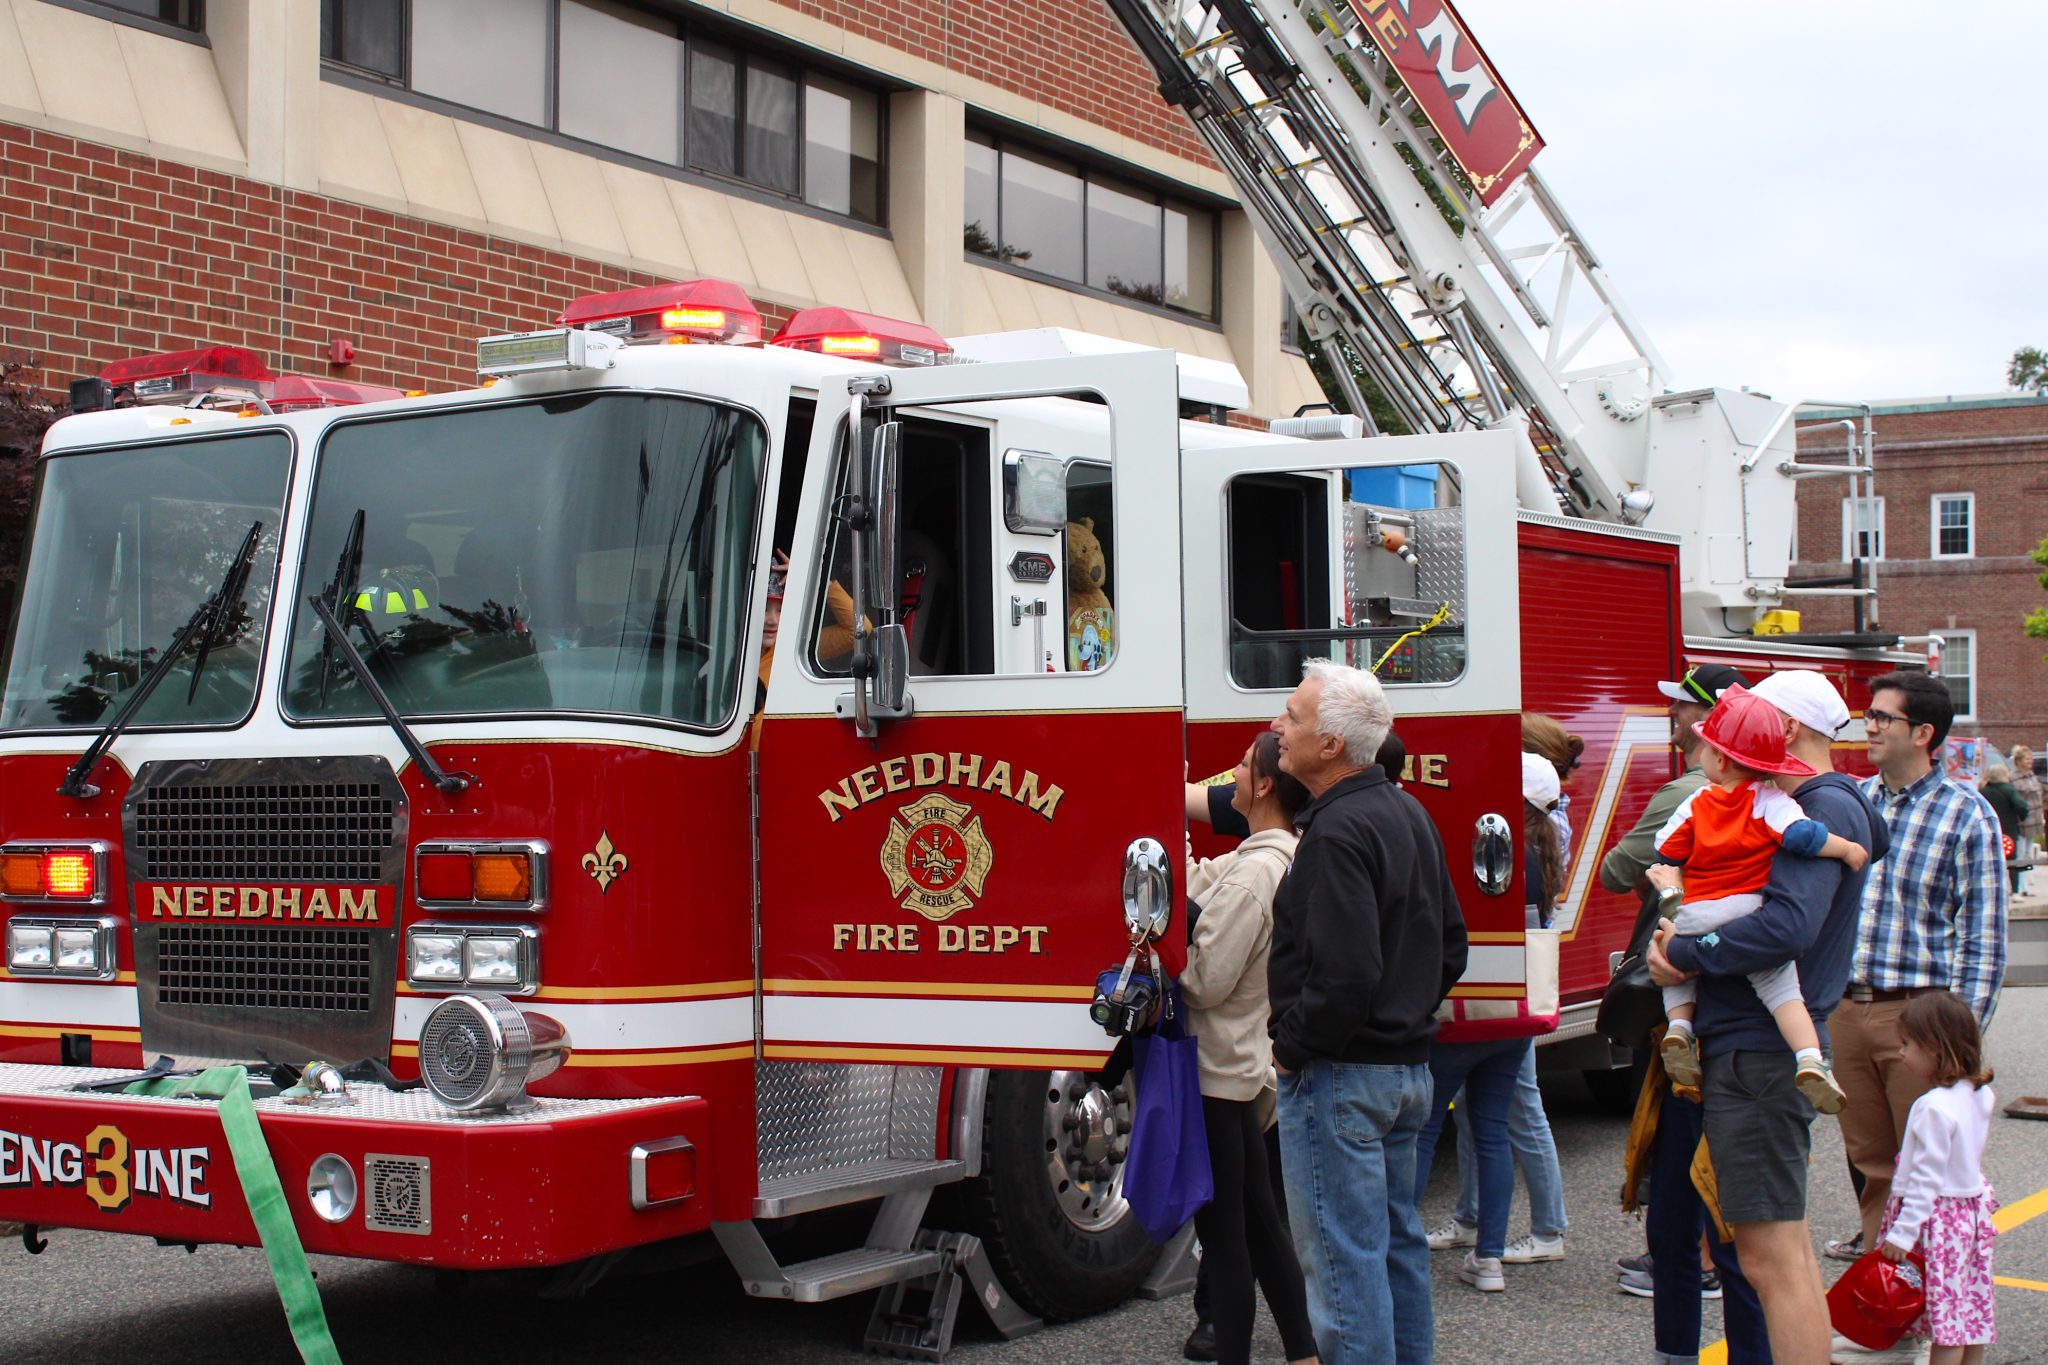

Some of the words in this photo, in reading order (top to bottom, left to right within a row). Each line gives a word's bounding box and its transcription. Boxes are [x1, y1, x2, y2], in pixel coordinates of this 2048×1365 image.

[1018, 560, 1046, 572] KME
[818, 752, 1065, 823] NEEDHAM
[923, 808, 946, 819] FIRE
[152, 886, 379, 920] NEEDHAM
[920, 894, 955, 906] RESCUE
[833, 923, 919, 951] FIRE
